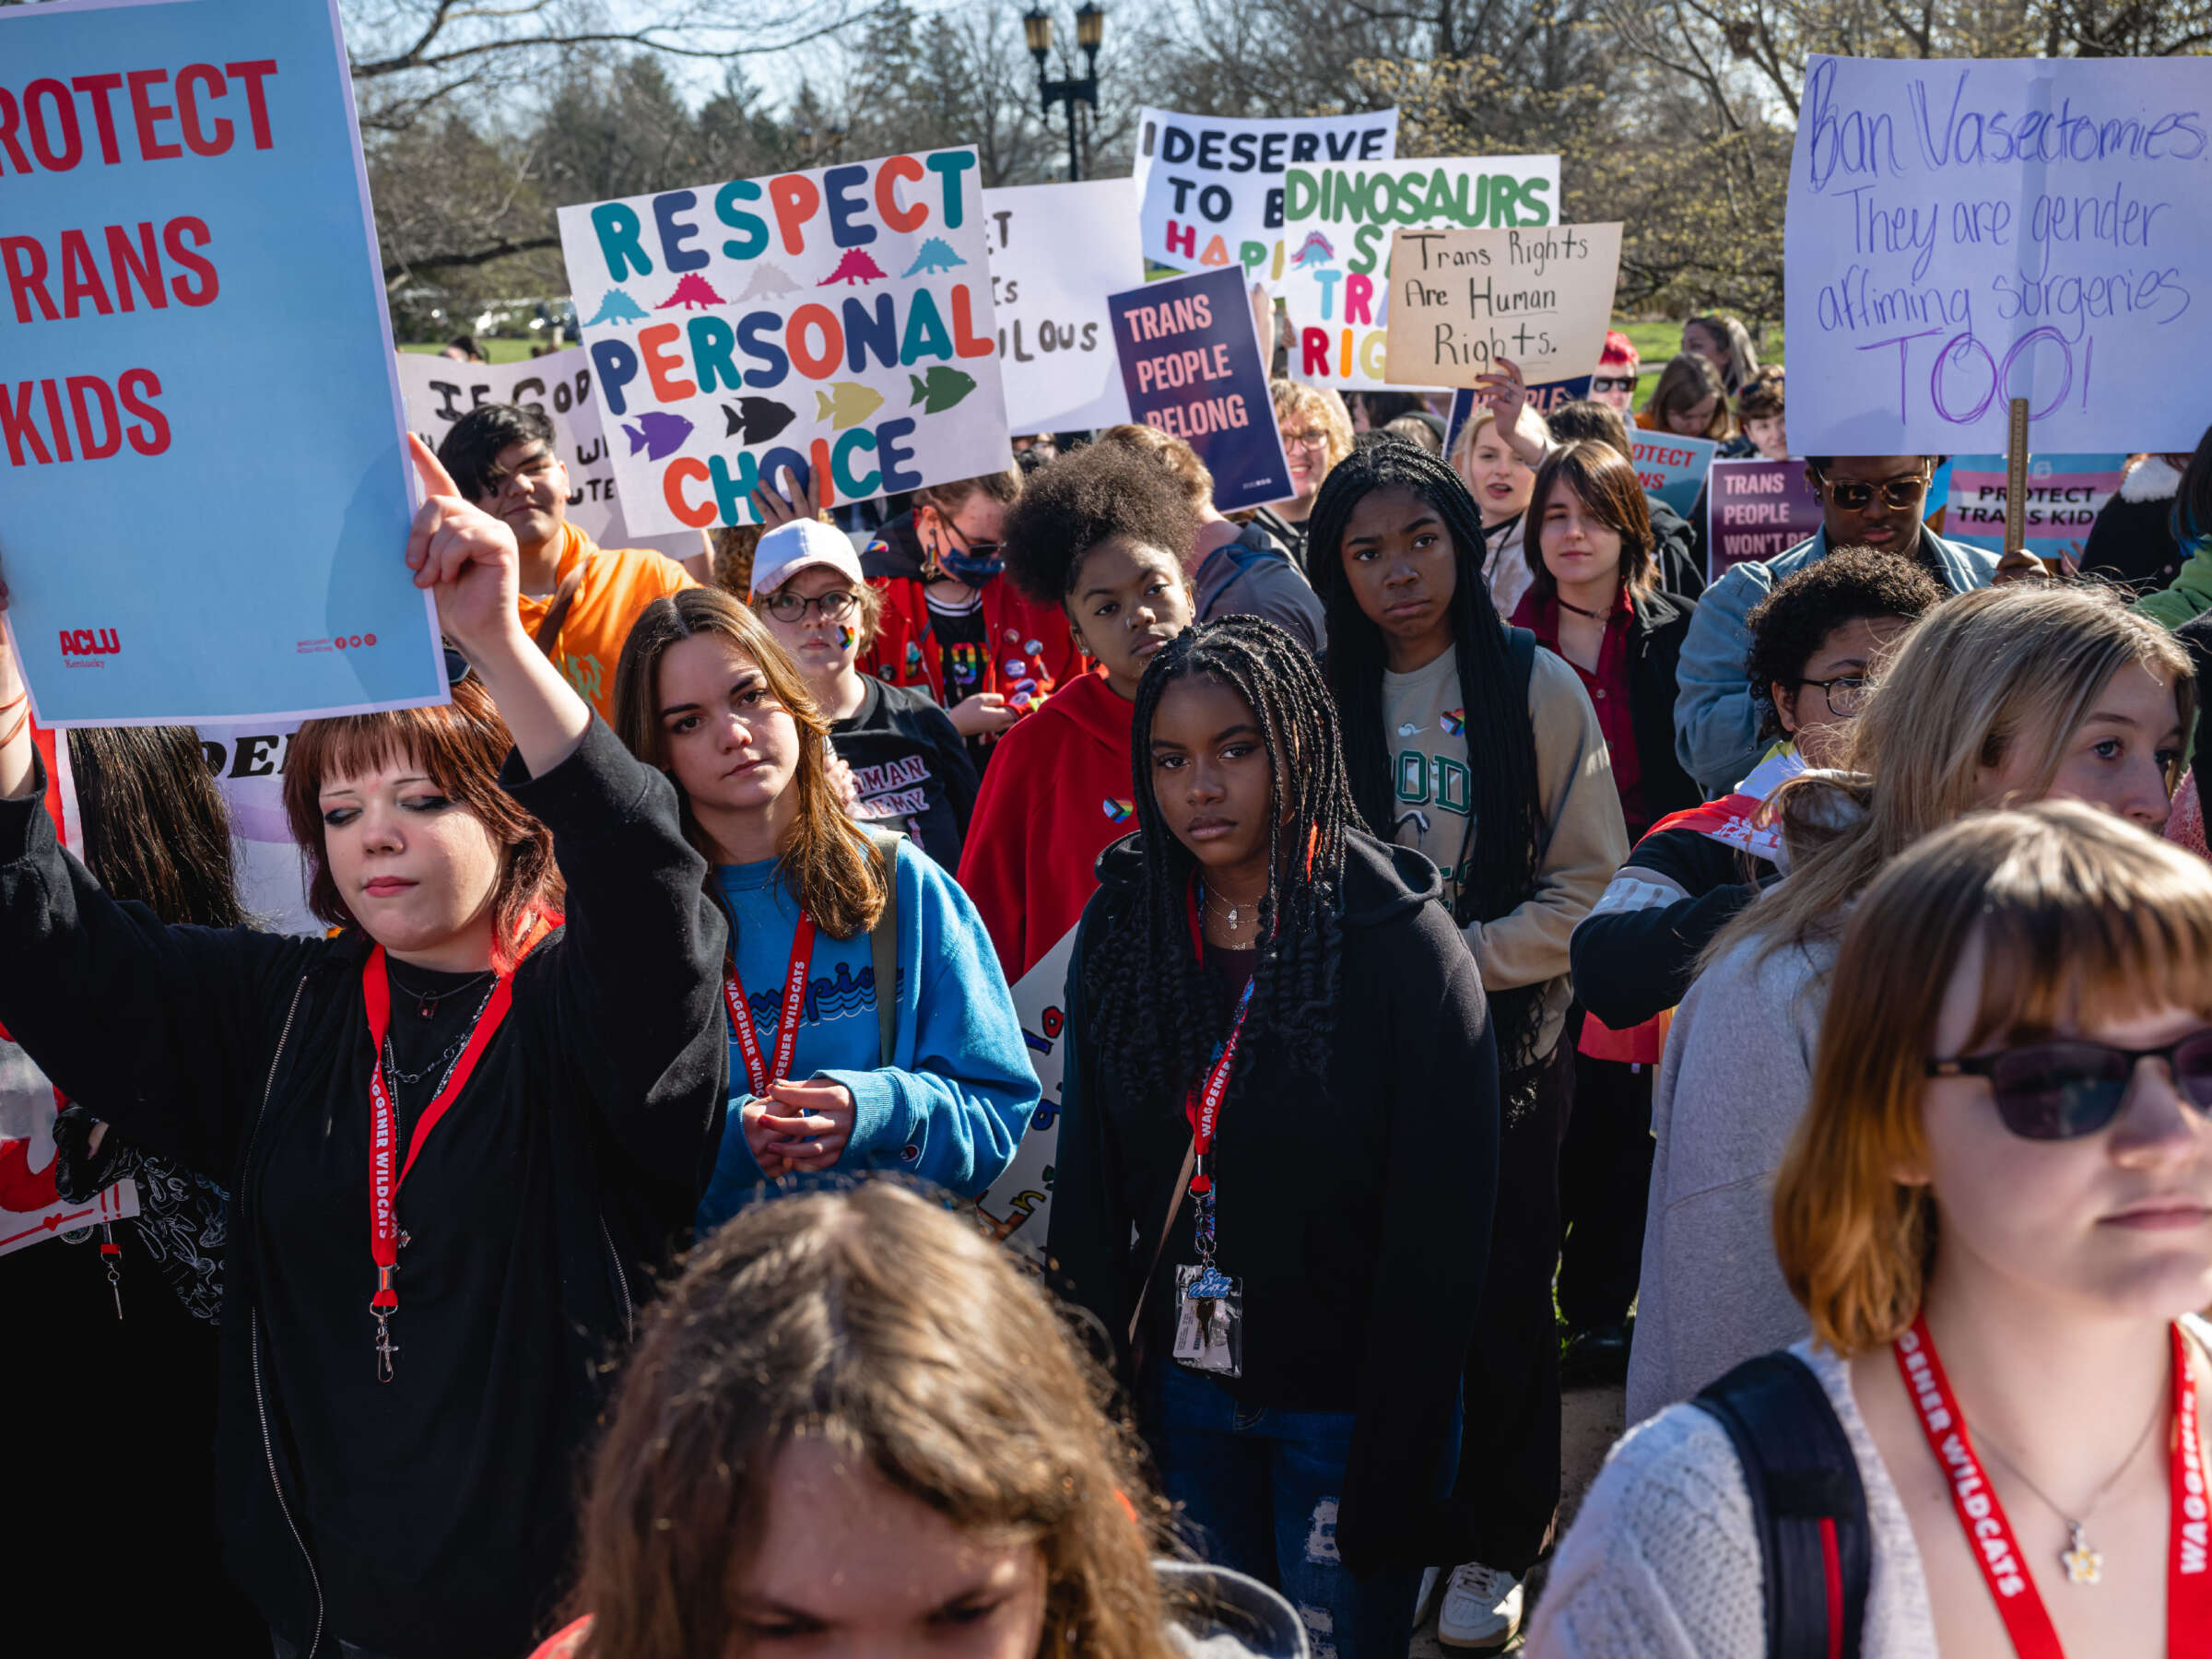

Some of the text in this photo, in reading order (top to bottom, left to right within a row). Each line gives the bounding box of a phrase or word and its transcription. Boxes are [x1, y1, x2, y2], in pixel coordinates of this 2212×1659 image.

[0, 59, 278, 176] ROTECT
[1807, 58, 1907, 193] Ban
[1162, 125, 1387, 173] DESERVE
[591, 150, 976, 283] RESPECT
[1168, 176, 1284, 229] TO B
[1286, 168, 1550, 229] DINOSAURS
[1401, 234, 1491, 270] Trans
[1509, 229, 1589, 276] Rights
[1831, 182, 2172, 284] They are gender
[0, 216, 220, 324] RANS
[1124, 294, 1213, 343] TRANS
[1405, 276, 1556, 320] Are Human
[1993, 267, 2191, 345] surgeries
[591, 284, 995, 416] PERSONAL
[1135, 344, 1233, 394] PEOPLE
[1856, 326, 2093, 426] TOO!
[0, 368, 171, 467] KIDS
[1146, 394, 1249, 440] BELONG
[664, 418, 923, 528] CHOICE
[1631, 442, 1698, 468] OTECT
[566, 478, 615, 506] UTE
[1724, 473, 1785, 496] TRANS
[1724, 502, 1791, 526] PEOPLE
[1957, 506, 2094, 526] TRAS KID
[1724, 532, 1784, 556] WON'T
[59, 628, 121, 655] ACLU
[784, 961, 805, 1030] WILDCATS
[775, 1032, 794, 1077] GENER
[1202, 1061, 1231, 1138] WAGGENER
[1201, 1268, 1233, 1286] Stay
[1899, 1329, 2026, 1598] GENER WILDCATS
